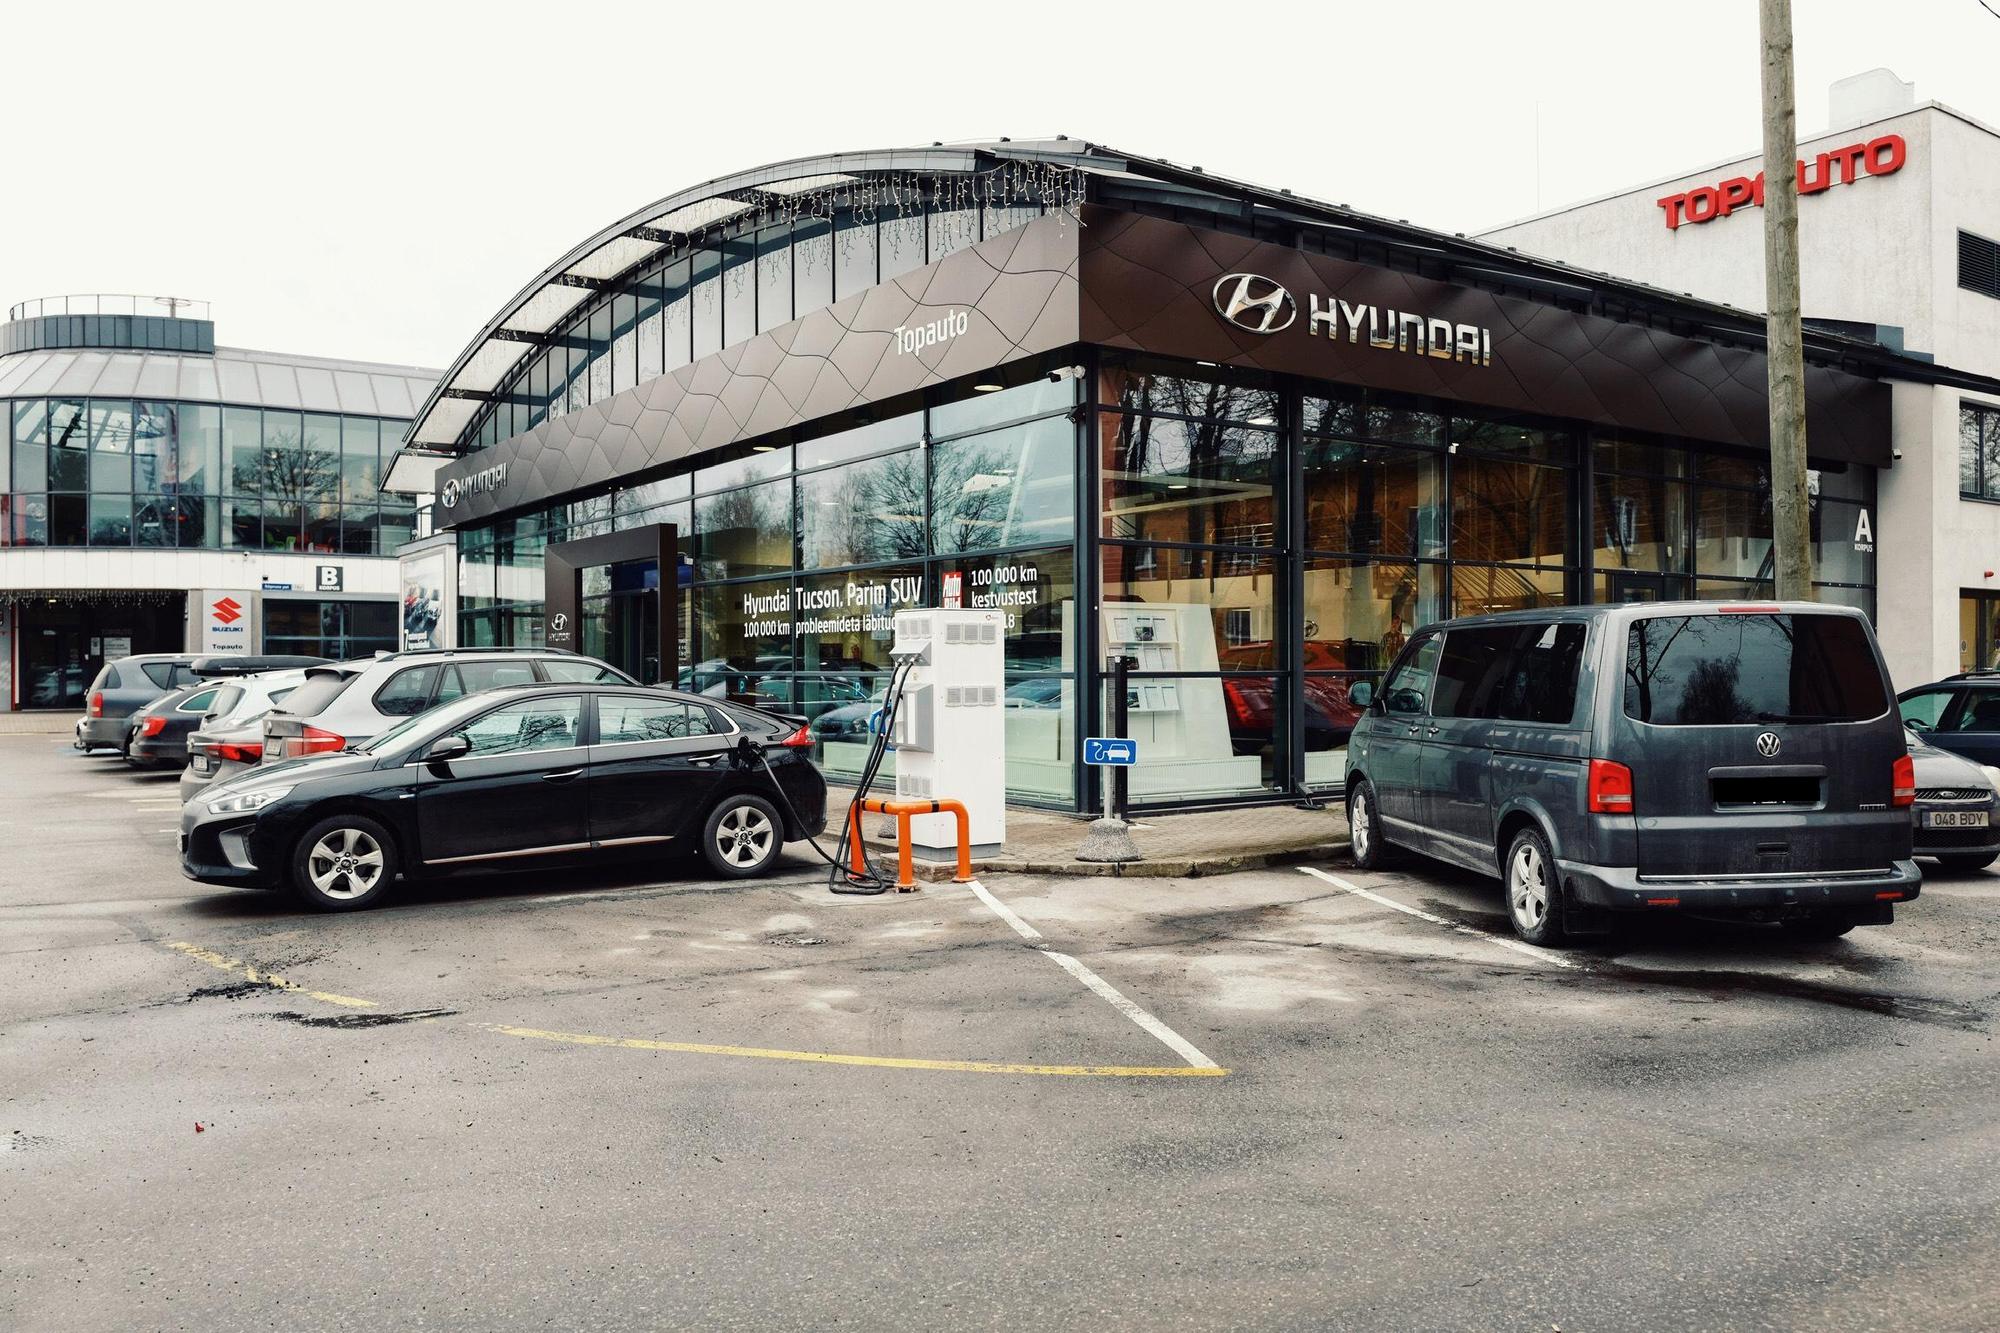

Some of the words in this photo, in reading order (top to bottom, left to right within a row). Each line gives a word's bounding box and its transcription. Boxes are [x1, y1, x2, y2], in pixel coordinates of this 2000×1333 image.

[1657, 134, 1907, 230] TOPUTO
[893, 308, 968, 357] Topauto
[1309, 293, 1490, 367] HYUNDAI
[460, 462, 507, 498] HYUNDAI
[1854, 508, 1873, 543] A
[321, 567, 338, 586] B
[943, 574, 962, 598] Auto
[971, 568, 992, 587] 100
[995, 566, 1017, 584] 000
[1020, 565, 1038, 582] km
[743, 588, 790, 619] Hyundai
[795, 587, 843, 610] Tucson.
[847, 579, 887, 606] Parim
[890, 575, 923, 604] SUV
[971, 587, 1038, 608] kestvustest
[743, 621, 758, 638] 100
[758, 620, 777, 637] 000
[777, 619, 790, 636] km
[795, 616, 861, 639] probleemideta
[212, 643, 244, 651] Topauto
[1934, 813, 1956, 826] 048
[1959, 812, 1984, 826] BDY
